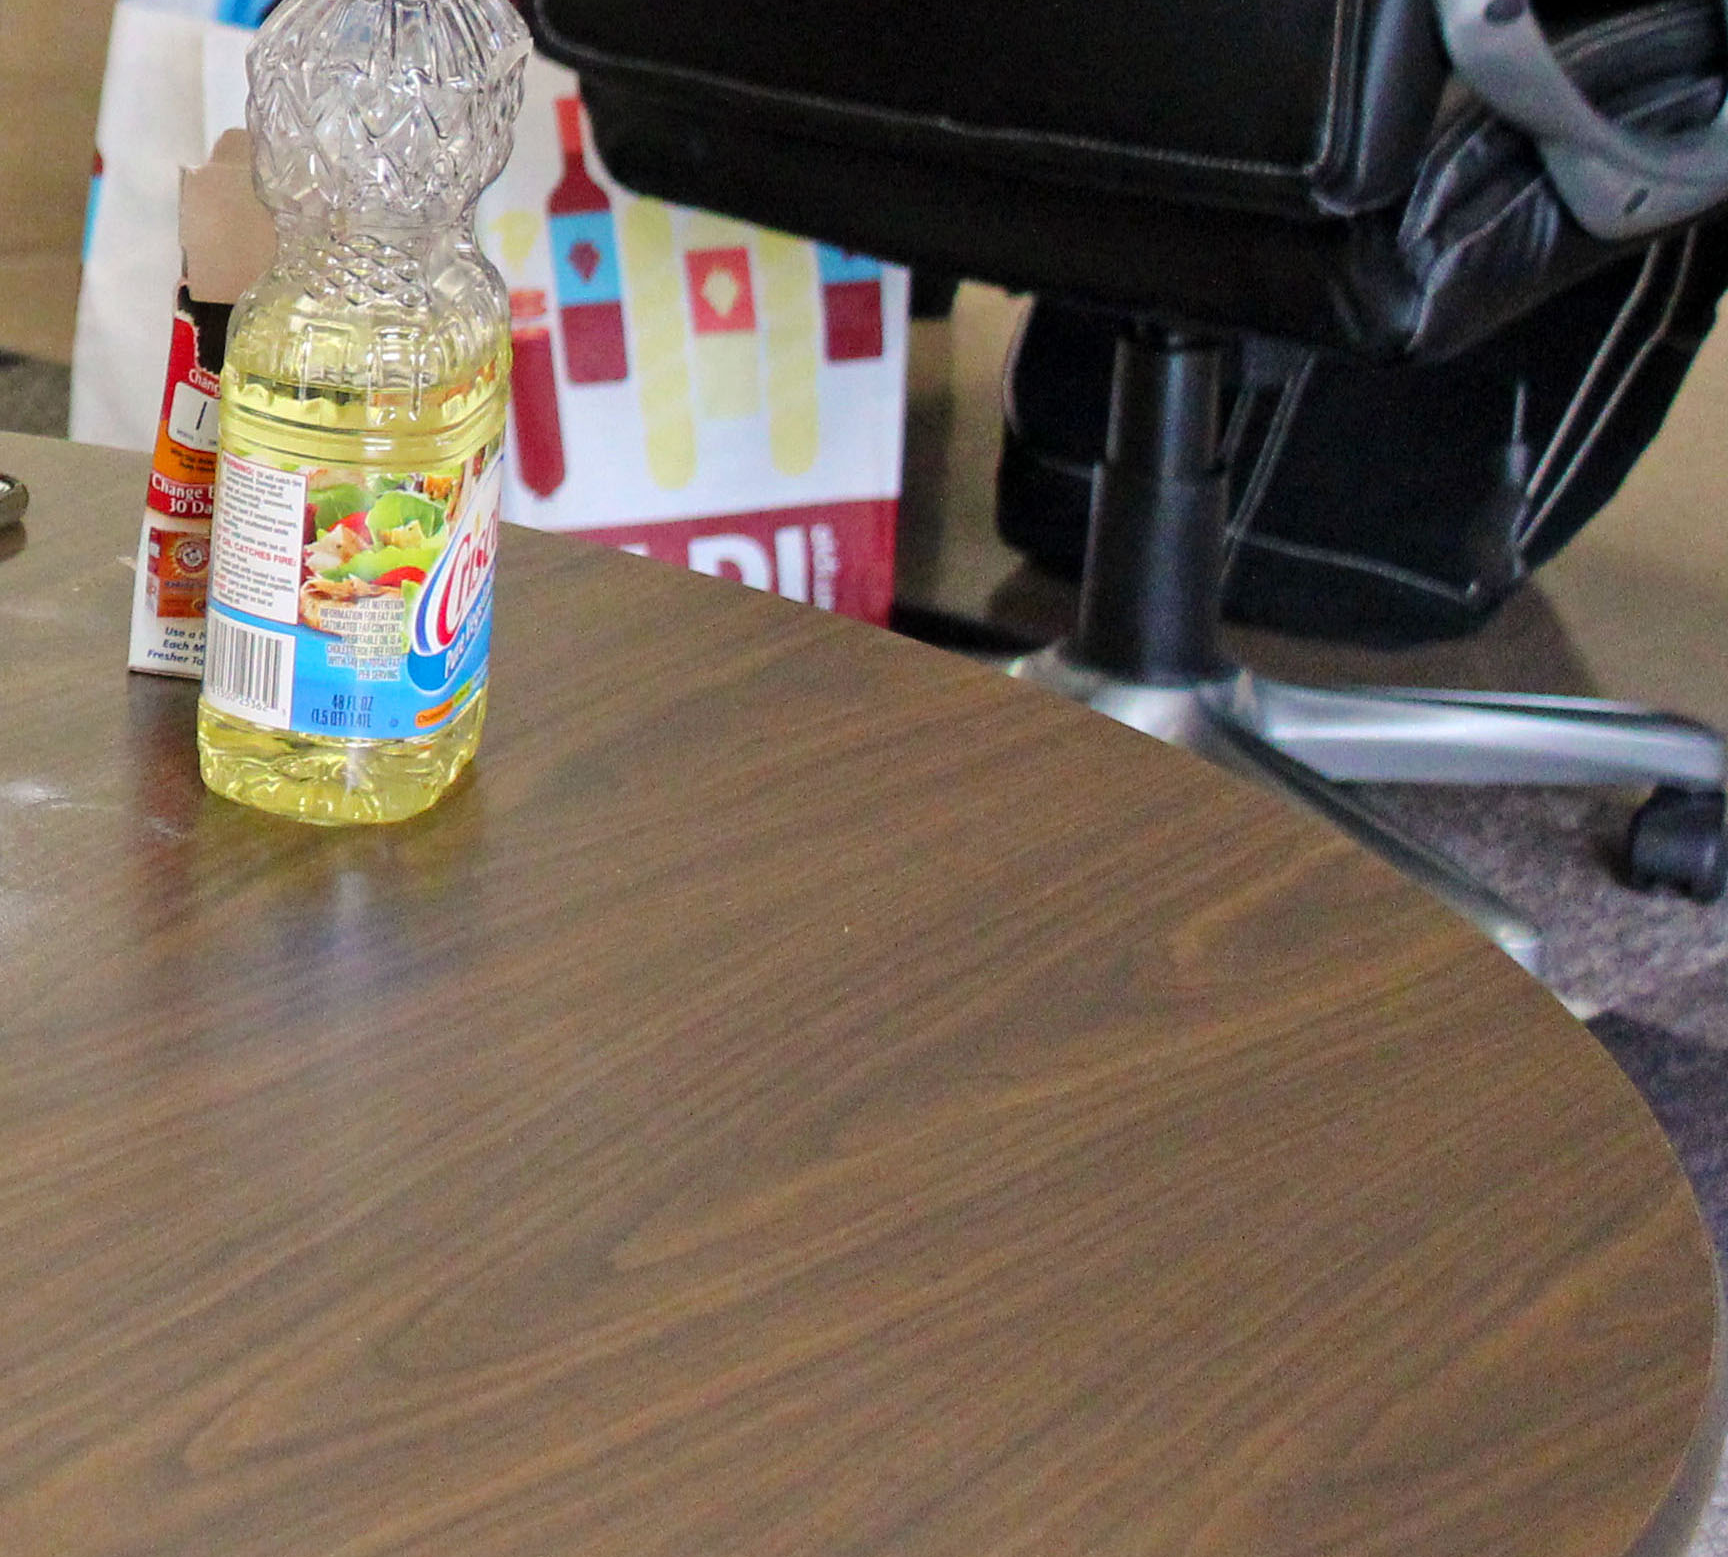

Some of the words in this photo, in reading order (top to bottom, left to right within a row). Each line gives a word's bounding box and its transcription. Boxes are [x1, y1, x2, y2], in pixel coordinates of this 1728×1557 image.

[151, 472, 204, 501] Change
[169, 497, 188, 514] 30
[234, 540, 272, 562] CATCHES
[273, 554, 298, 568] FIRE:
[165, 626, 186, 639] Use
[188, 631, 196, 640] a
[162, 639, 189, 652] Each
[147, 649, 189, 664] Fresher
[332, 693, 344, 710] 48
[346, 695, 357, 711] FL
[360, 696, 374, 712] OZ
